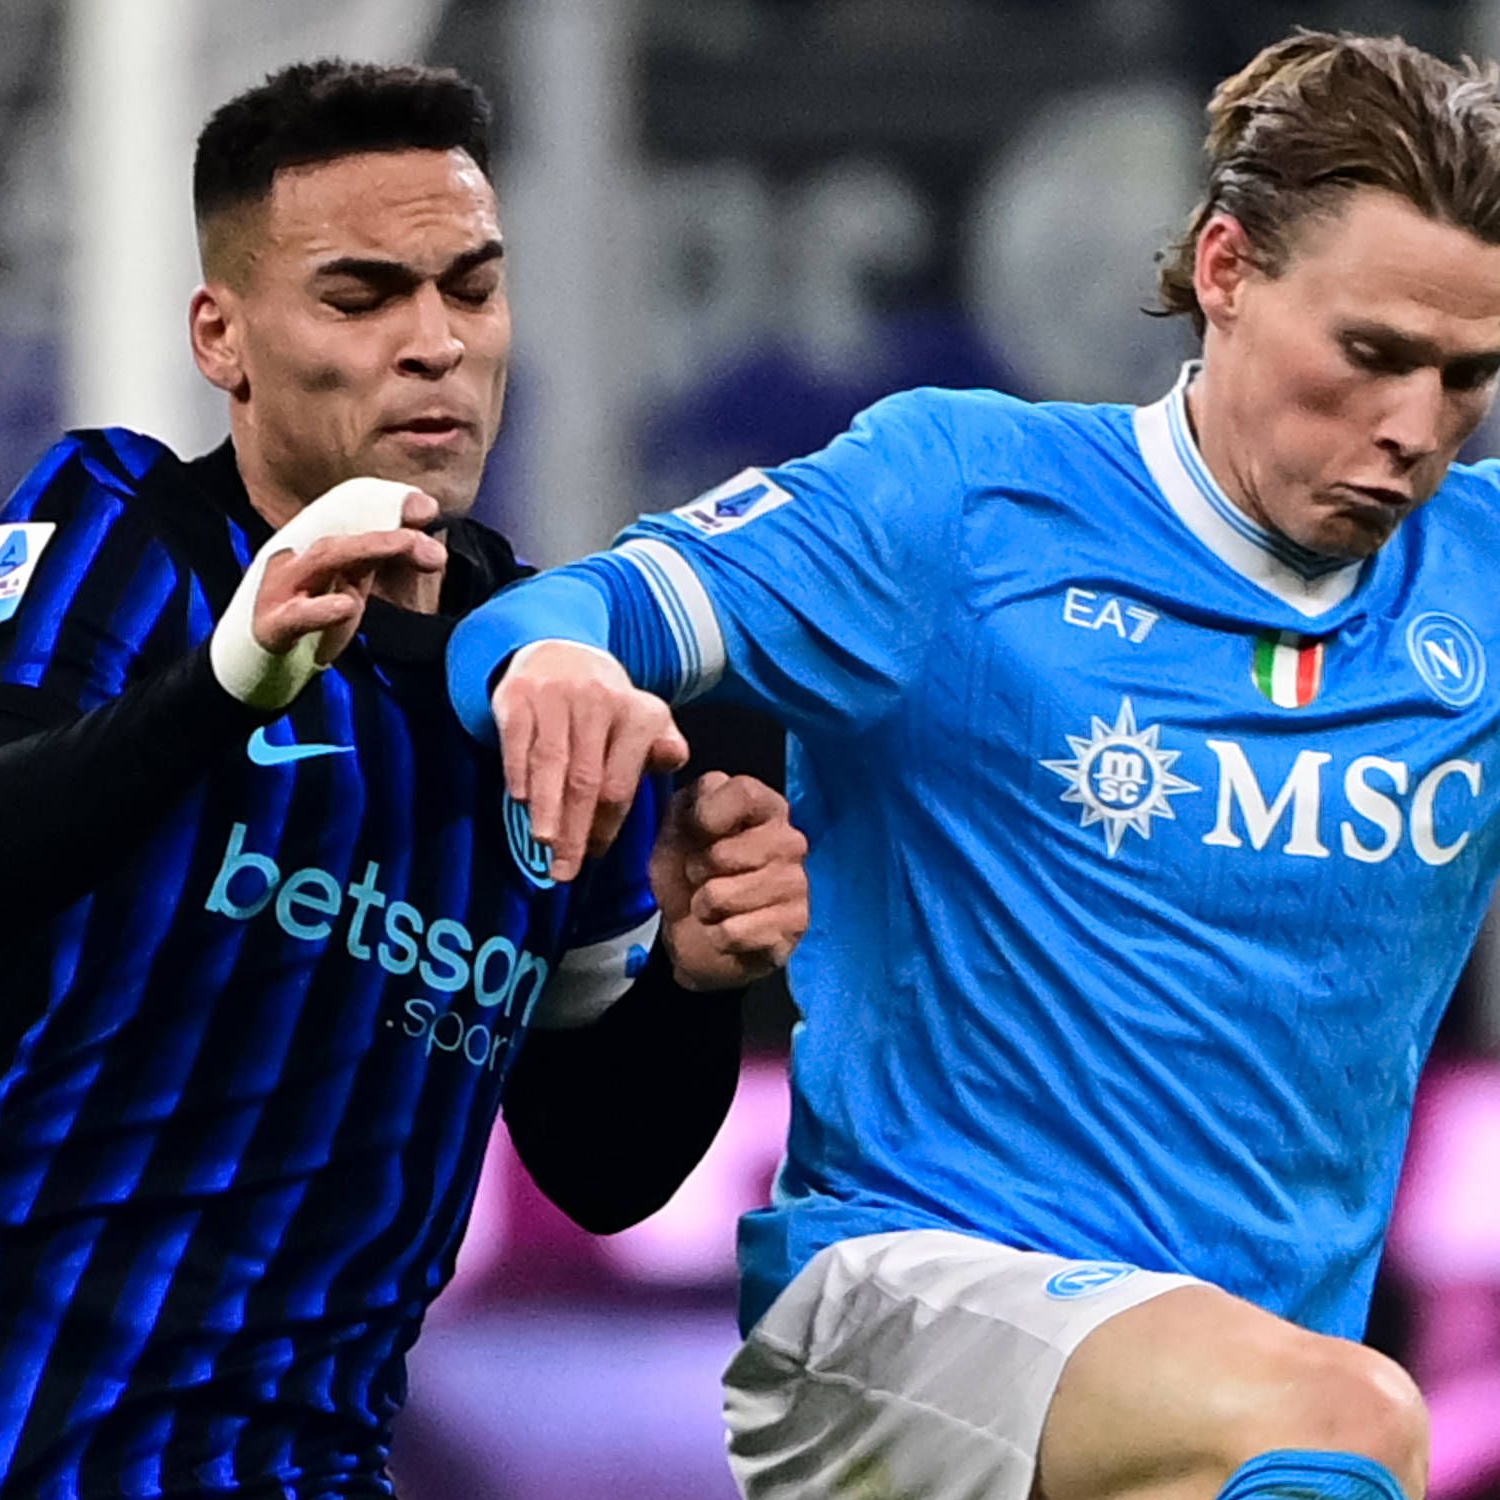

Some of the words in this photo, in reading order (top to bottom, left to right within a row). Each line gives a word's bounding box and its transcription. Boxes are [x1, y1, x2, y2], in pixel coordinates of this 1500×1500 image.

[1063, 586, 1161, 644] EA7
[1422, 637, 1463, 680] N
[1202, 739, 1484, 866] MSC
[204, 822, 549, 1026] betsson
[385, 998, 514, 1073] .spor
